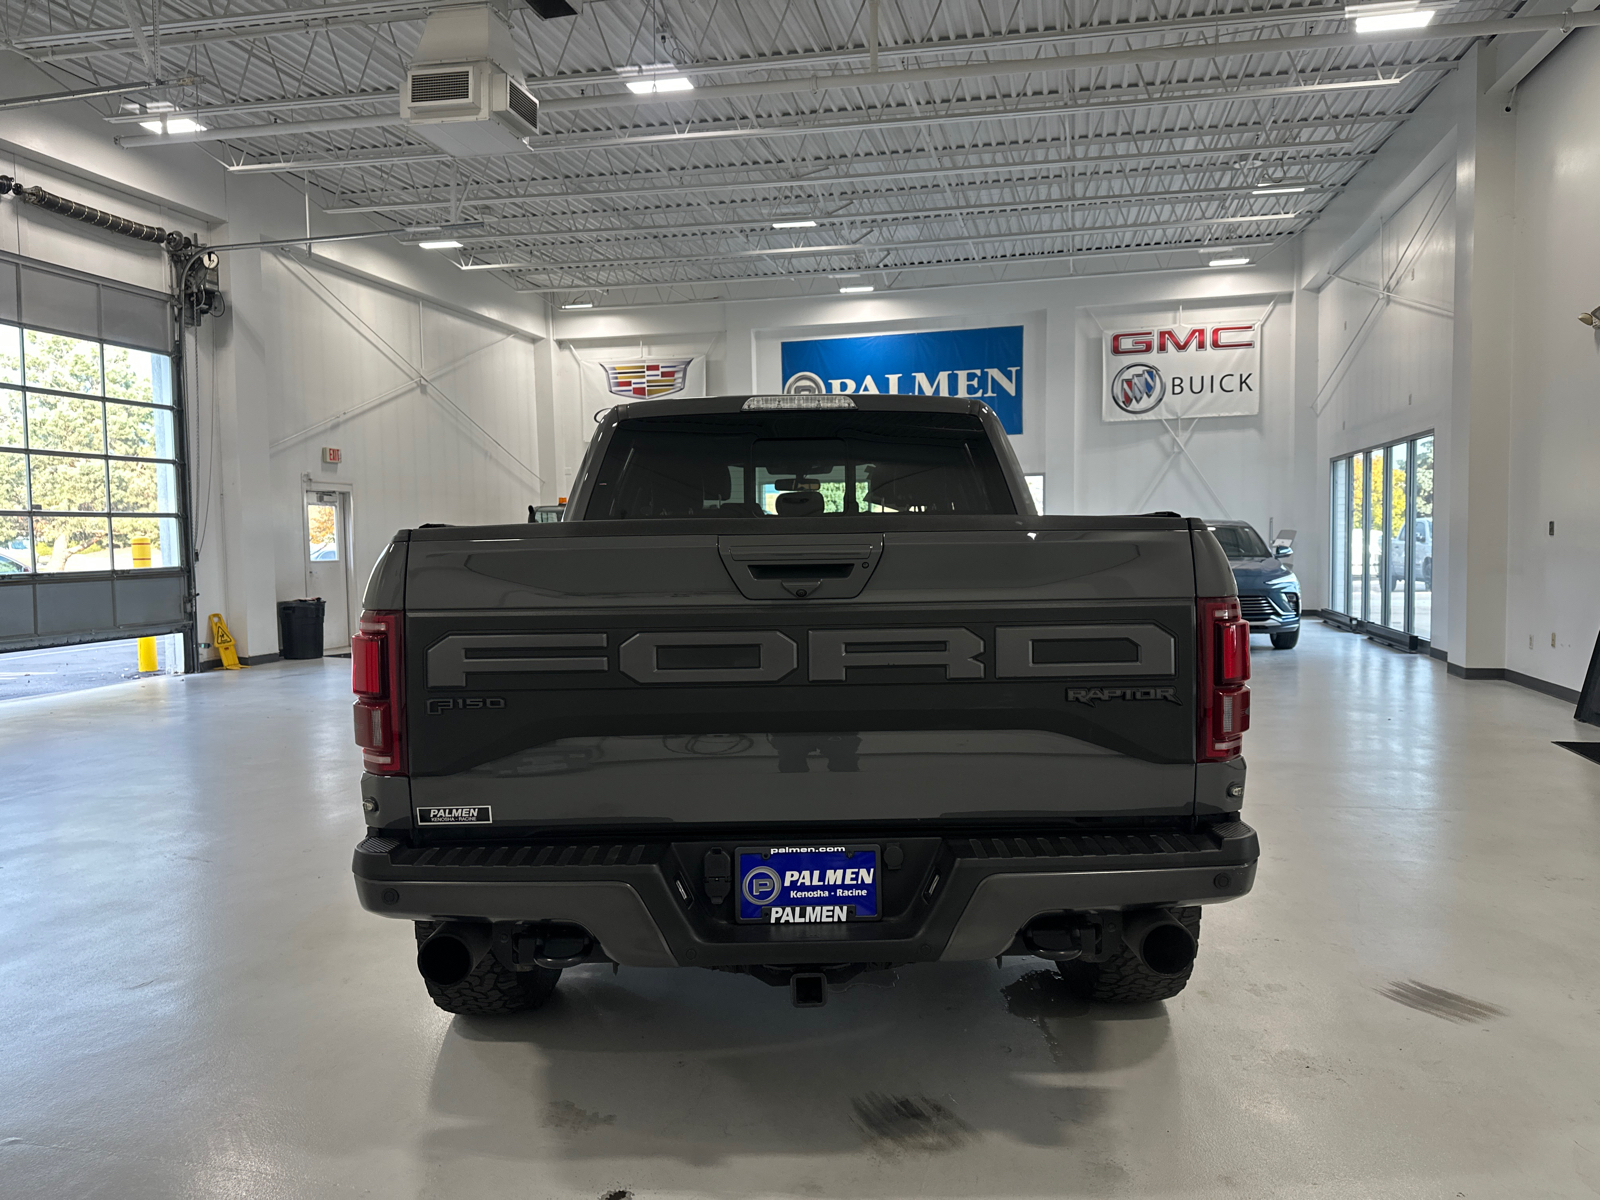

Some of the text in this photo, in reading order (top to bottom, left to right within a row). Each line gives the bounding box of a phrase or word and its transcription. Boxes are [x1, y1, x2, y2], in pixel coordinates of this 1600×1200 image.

[1111, 324, 1256, 356] GMC
[828, 366, 1021, 398] PALMEN
[1171, 373, 1254, 396] BUICK
[329, 448, 340, 462] EXIT
[426, 623, 1176, 688] FORD
[1066, 686, 1183, 707] RAPTOR
[430, 808, 478, 818] PALMEN
[770, 846, 846, 855] palmen.com
[784, 868, 874, 887] PALMEN
[790, 890, 829, 899] Kenosha
[836, 889, 868, 897] Racine
[770, 905, 848, 924] PALMEN
